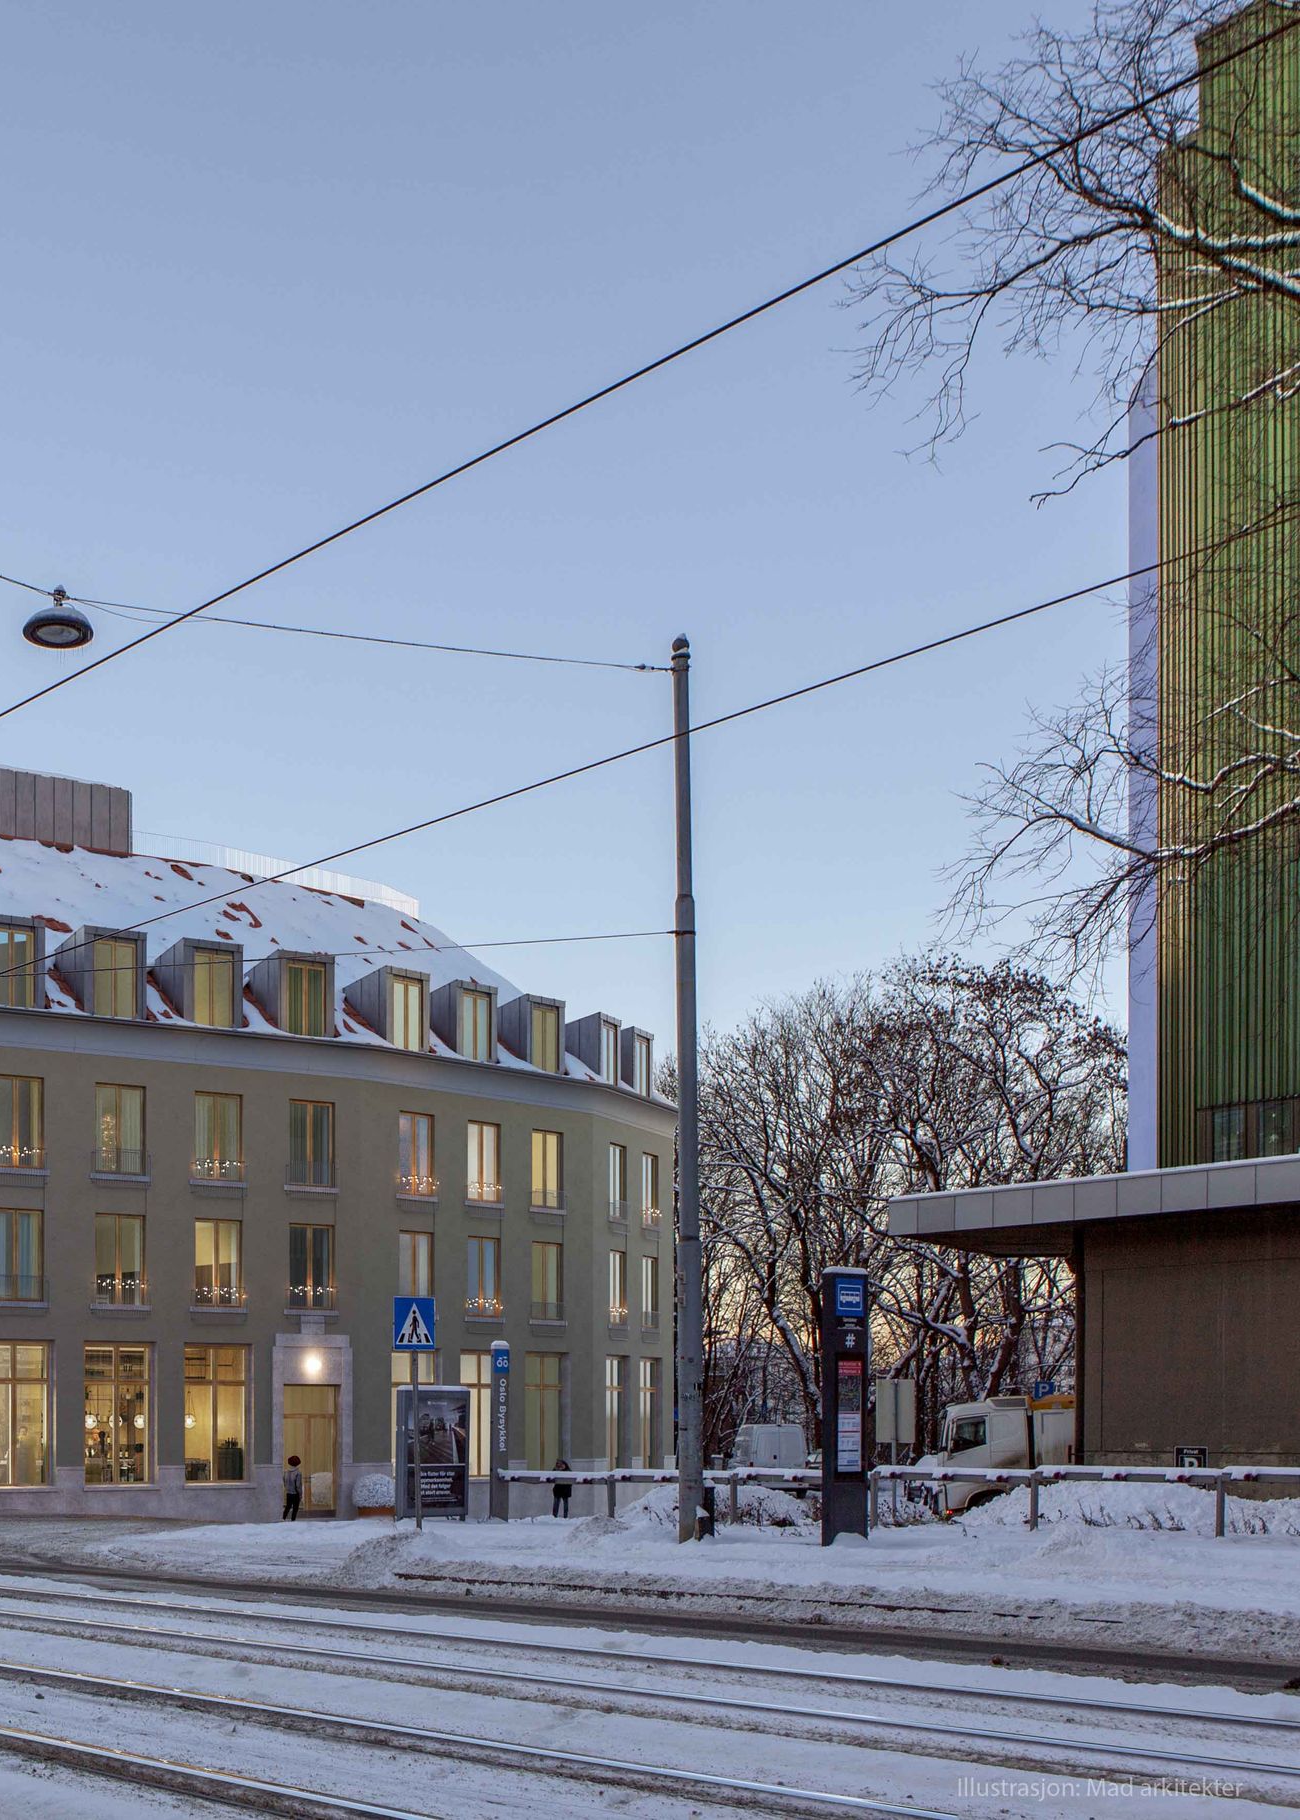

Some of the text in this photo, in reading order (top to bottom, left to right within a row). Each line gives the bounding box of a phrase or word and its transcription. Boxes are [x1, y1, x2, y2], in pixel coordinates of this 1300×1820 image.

[1039, 1384, 1049, 1397] P
[497, 1378, 507, 1452] Oslo Bysykkel
